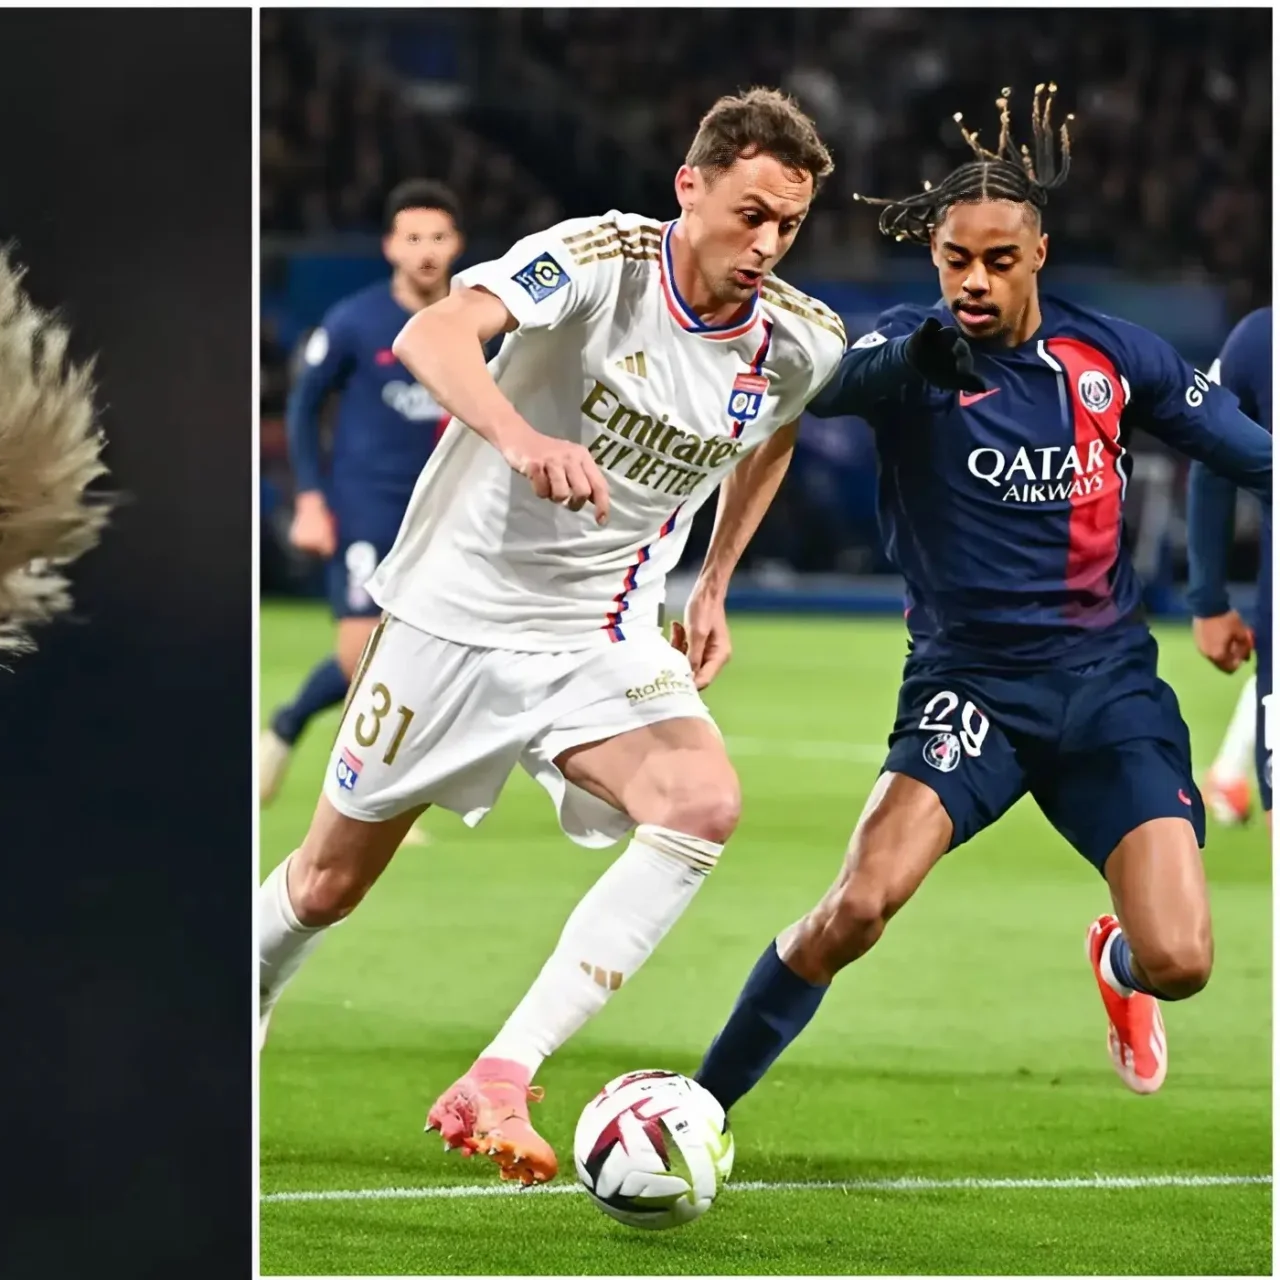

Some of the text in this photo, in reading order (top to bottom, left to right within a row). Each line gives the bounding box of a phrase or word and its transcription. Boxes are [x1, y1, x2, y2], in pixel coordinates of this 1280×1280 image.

[732, 392, 757, 415] OL
[967, 439, 1105, 487] QATAR
[1002, 471, 1104, 502] AIRWAYS
[355, 682, 415, 766] 31
[918, 690, 990, 757] 29
